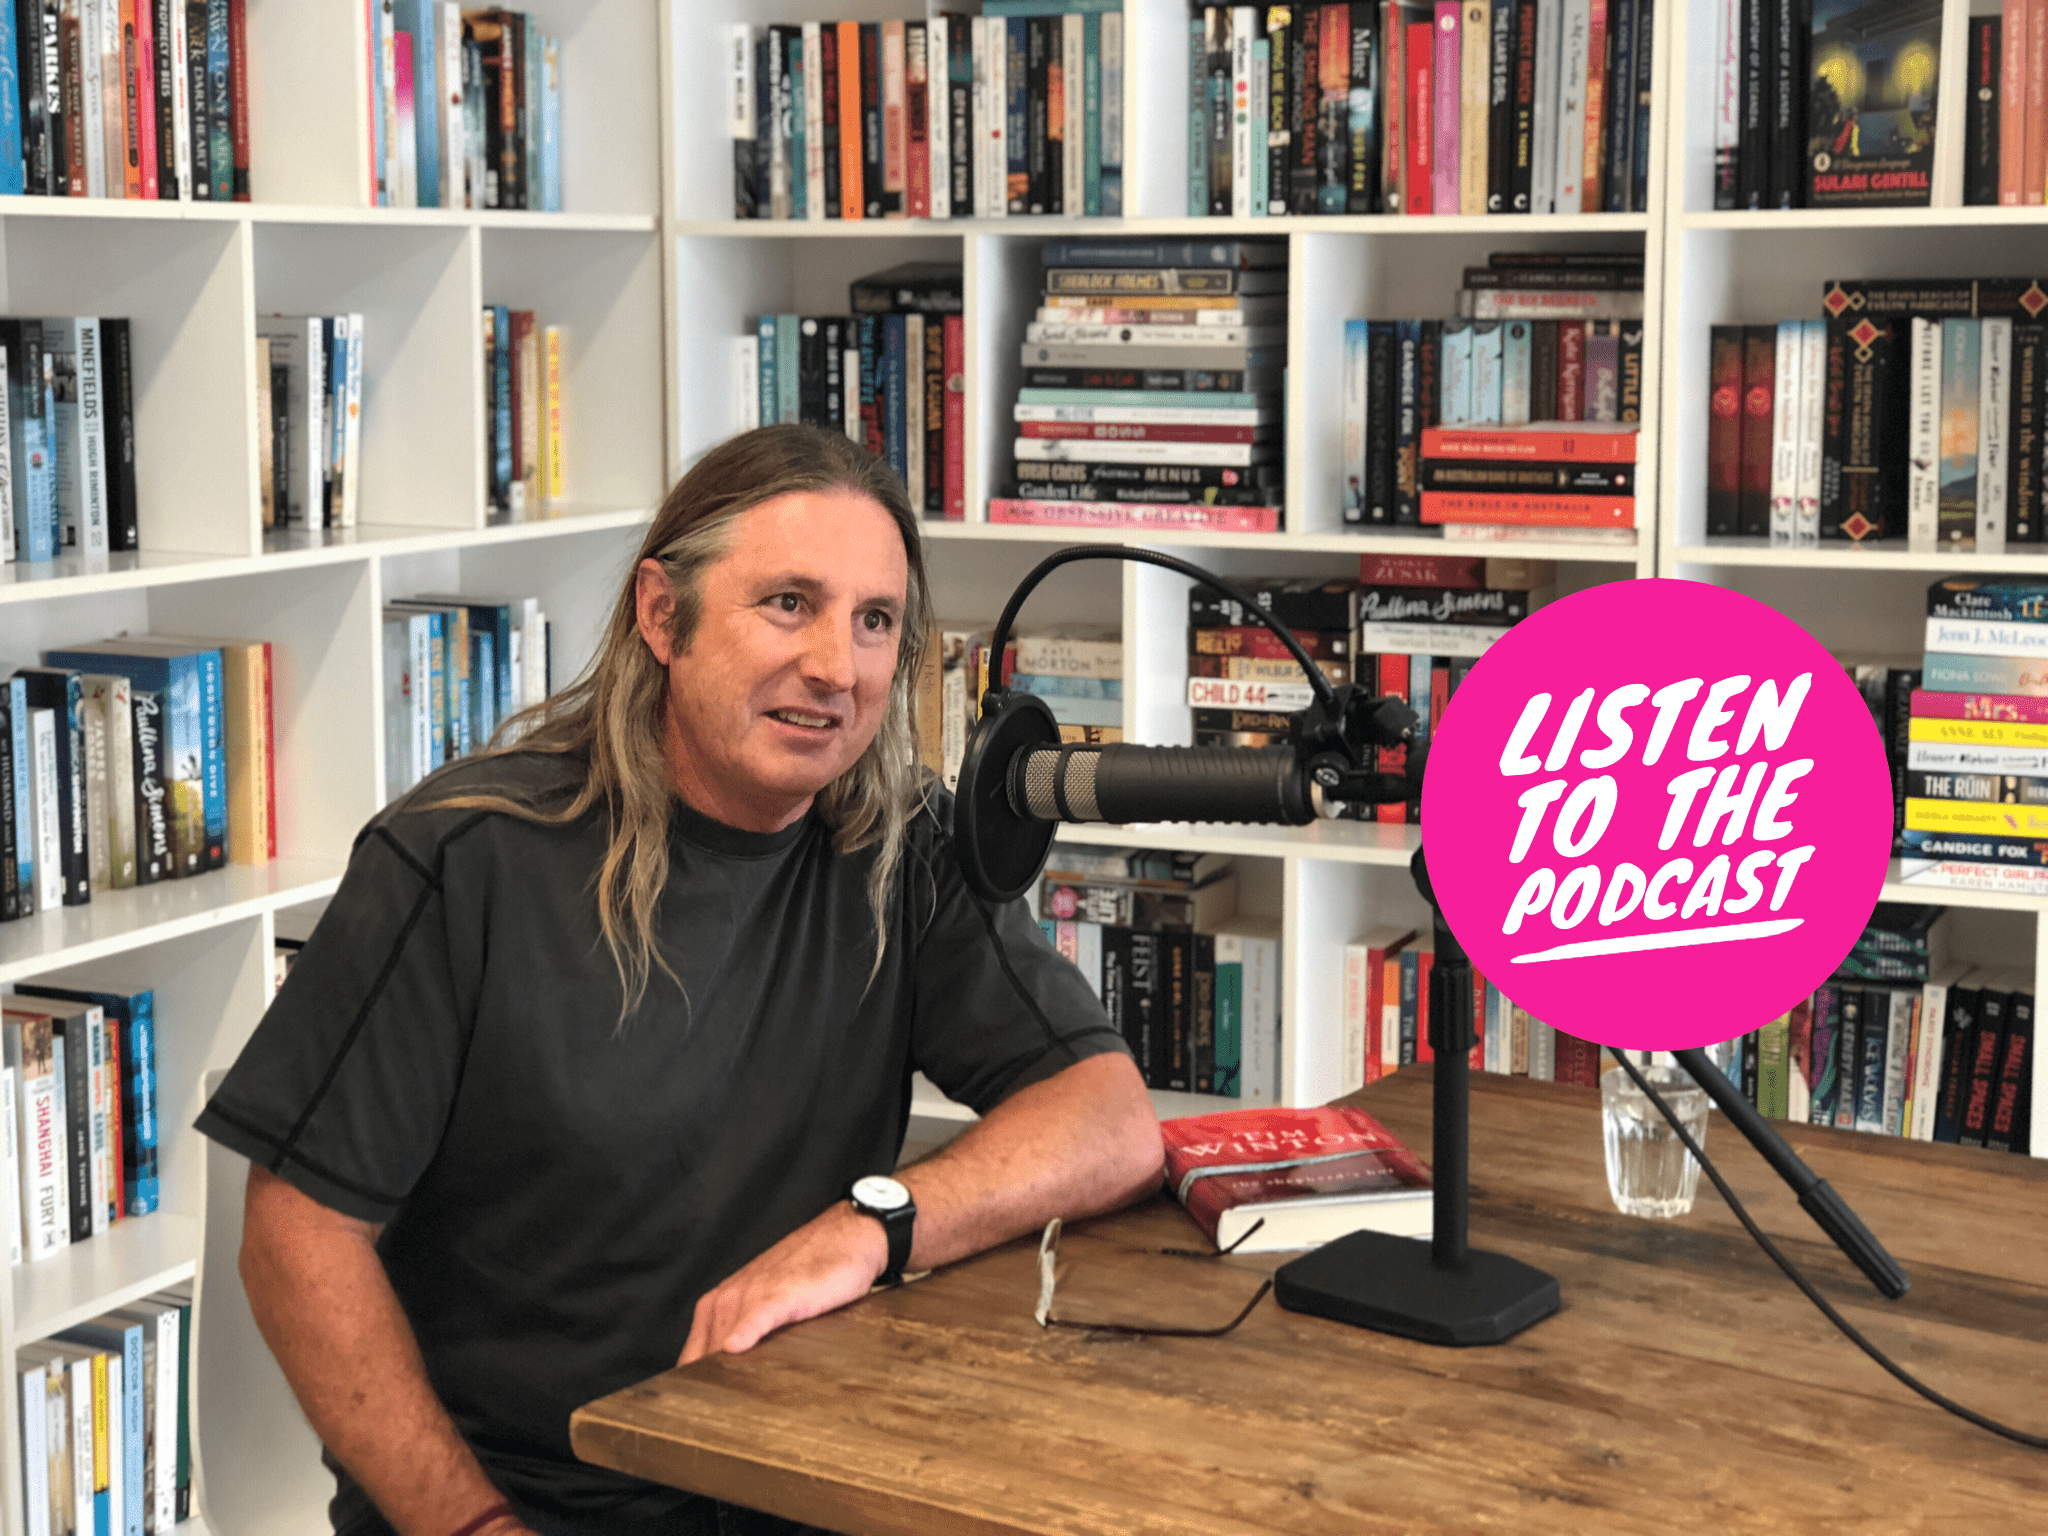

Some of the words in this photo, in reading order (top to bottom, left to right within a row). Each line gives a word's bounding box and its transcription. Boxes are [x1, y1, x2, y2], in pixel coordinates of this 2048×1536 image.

[1303, 12, 1317, 44] THE
[1494, 8, 1509, 33] THE
[43, 14, 61, 114] PARKES
[1236, 37, 1248, 75] When
[1353, 29, 1371, 80] Mine
[161, 70, 172, 97] BEES
[193, 66, 206, 112] DARK
[195, 115, 207, 170] HEART
[1302, 123, 1316, 166] MAN
[1920, 325, 1933, 371] BEFORE
[81, 328, 99, 419] MINEFIELDS
[1402, 340, 1415, 406] CANDICE
[2021, 346, 2035, 403] woman
[927, 374, 942, 431] LAGUNA
[1920, 385, 1932, 406] LET
[1402, 408, 1414, 436] FOX
[1920, 412, 1931, 434] YOU
[2020, 407, 2035, 424] in
[87, 436, 99, 468] HUGH
[2020, 428, 2035, 453] the
[1144, 467, 1201, 483] MENUS
[2017, 457, 2033, 520] window
[88, 471, 102, 527] RIMINTON
[1070, 484, 1098, 501] Life
[1360, 591, 1430, 622] Paullina
[1432, 590, 1504, 621] Simons
[1934, 603, 2013, 621] Mackintosh
[1954, 592, 1992, 607] Clare
[1937, 626, 1970, 643] Jenn
[1024, 655, 1092, 672] MORTON
[1192, 682, 1240, 704] CHILD
[1244, 685, 1266, 705] 44
[1963, 694, 2028, 721] Mrs.
[94, 720, 106, 782] JASPER
[134, 694, 161, 776] Paullina
[85, 725, 97, 781] JONES
[2, 757, 16, 823] HUSBAND
[1924, 775, 1952, 797] THE
[142, 778, 165, 856] Simons
[1920, 840, 1993, 856] CANDICE
[1997, 844, 2028, 858] FOX
[1940, 863, 1998, 877] PERFECT
[1949, 877, 1991, 888] KAREN
[1107, 950, 1117, 968] The
[1131, 933, 1152, 994] FEIST
[1172, 946, 1182, 978] GONE
[1107, 969, 1117, 990] Time
[1172, 981, 1181, 1006] GIRL
[1841, 1020, 1855, 1071] KENSY
[1975, 1030, 1996, 1075] SMALL
[2004, 1033, 2025, 1078] SMALL
[1966, 1078, 1988, 1130] SPACES
[1994, 1080, 2017, 1133] SPACES
[37, 1096, 54, 1178] SHANGHAI
[1232, 1180, 1260, 1189] the
[41, 1186, 57, 1227] FURY
